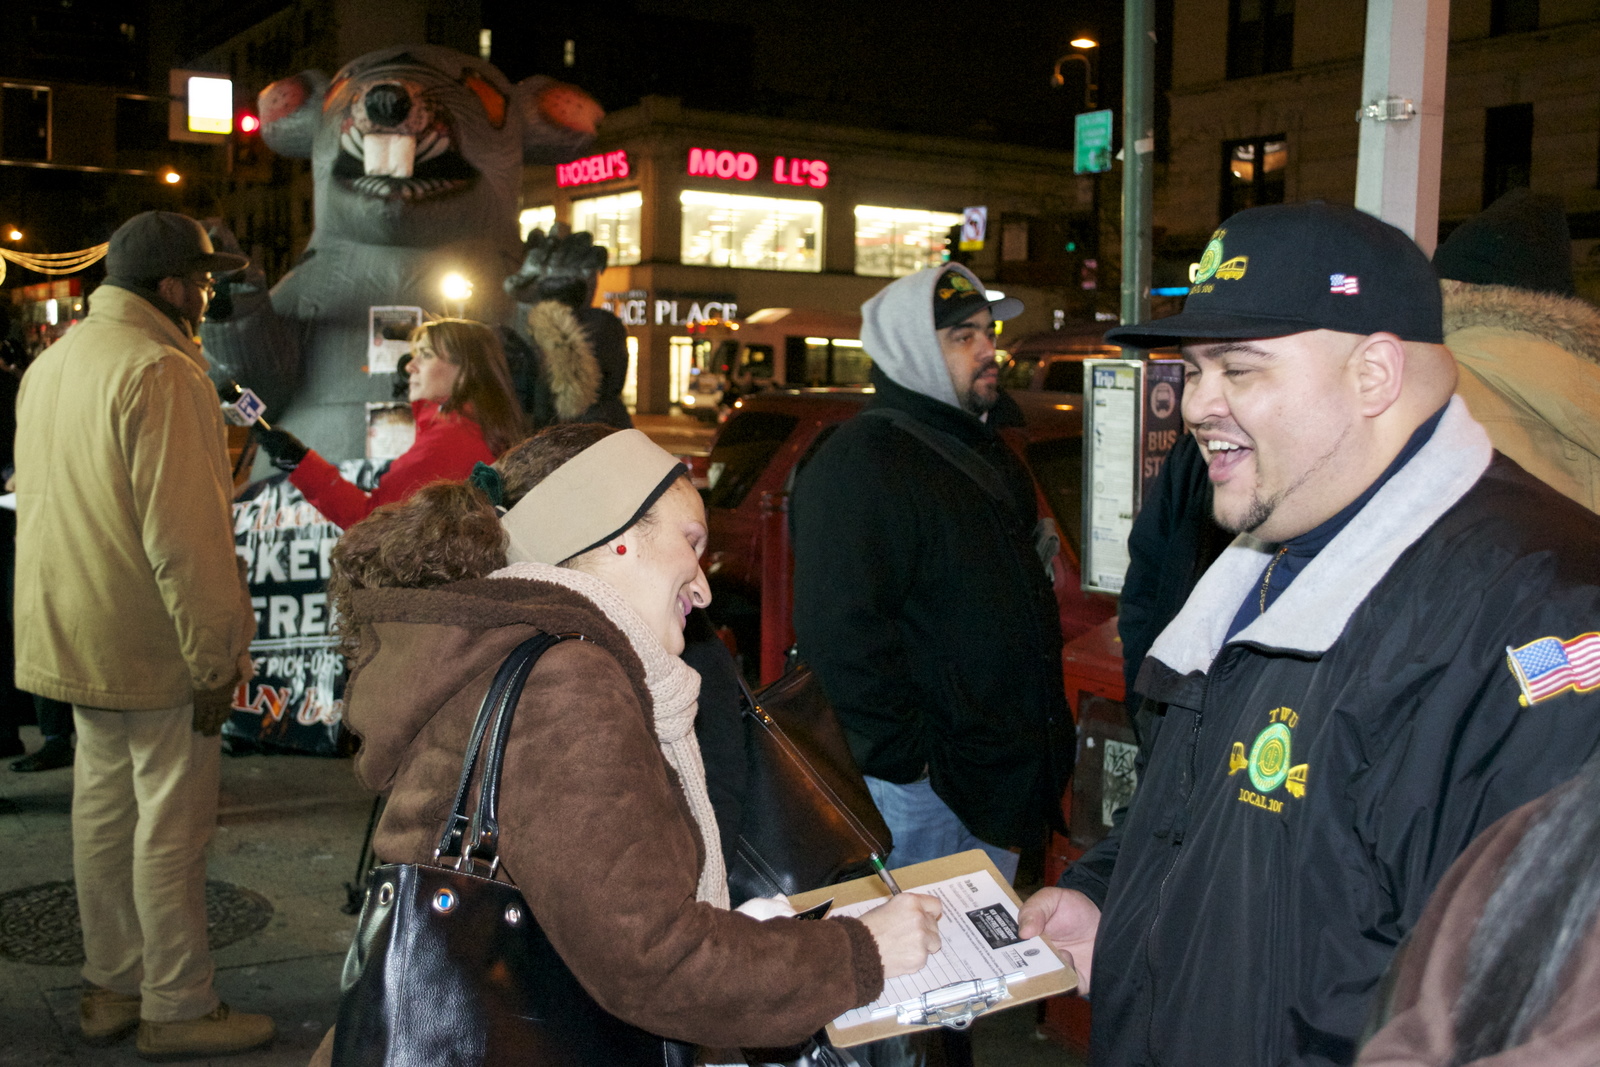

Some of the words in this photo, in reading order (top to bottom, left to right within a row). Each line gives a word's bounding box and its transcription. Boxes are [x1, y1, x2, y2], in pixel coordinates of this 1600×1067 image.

[655, 300, 738, 326] PLACE
[1148, 430, 1177, 450] BUS
[1269, 706, 1299, 728] TWU
